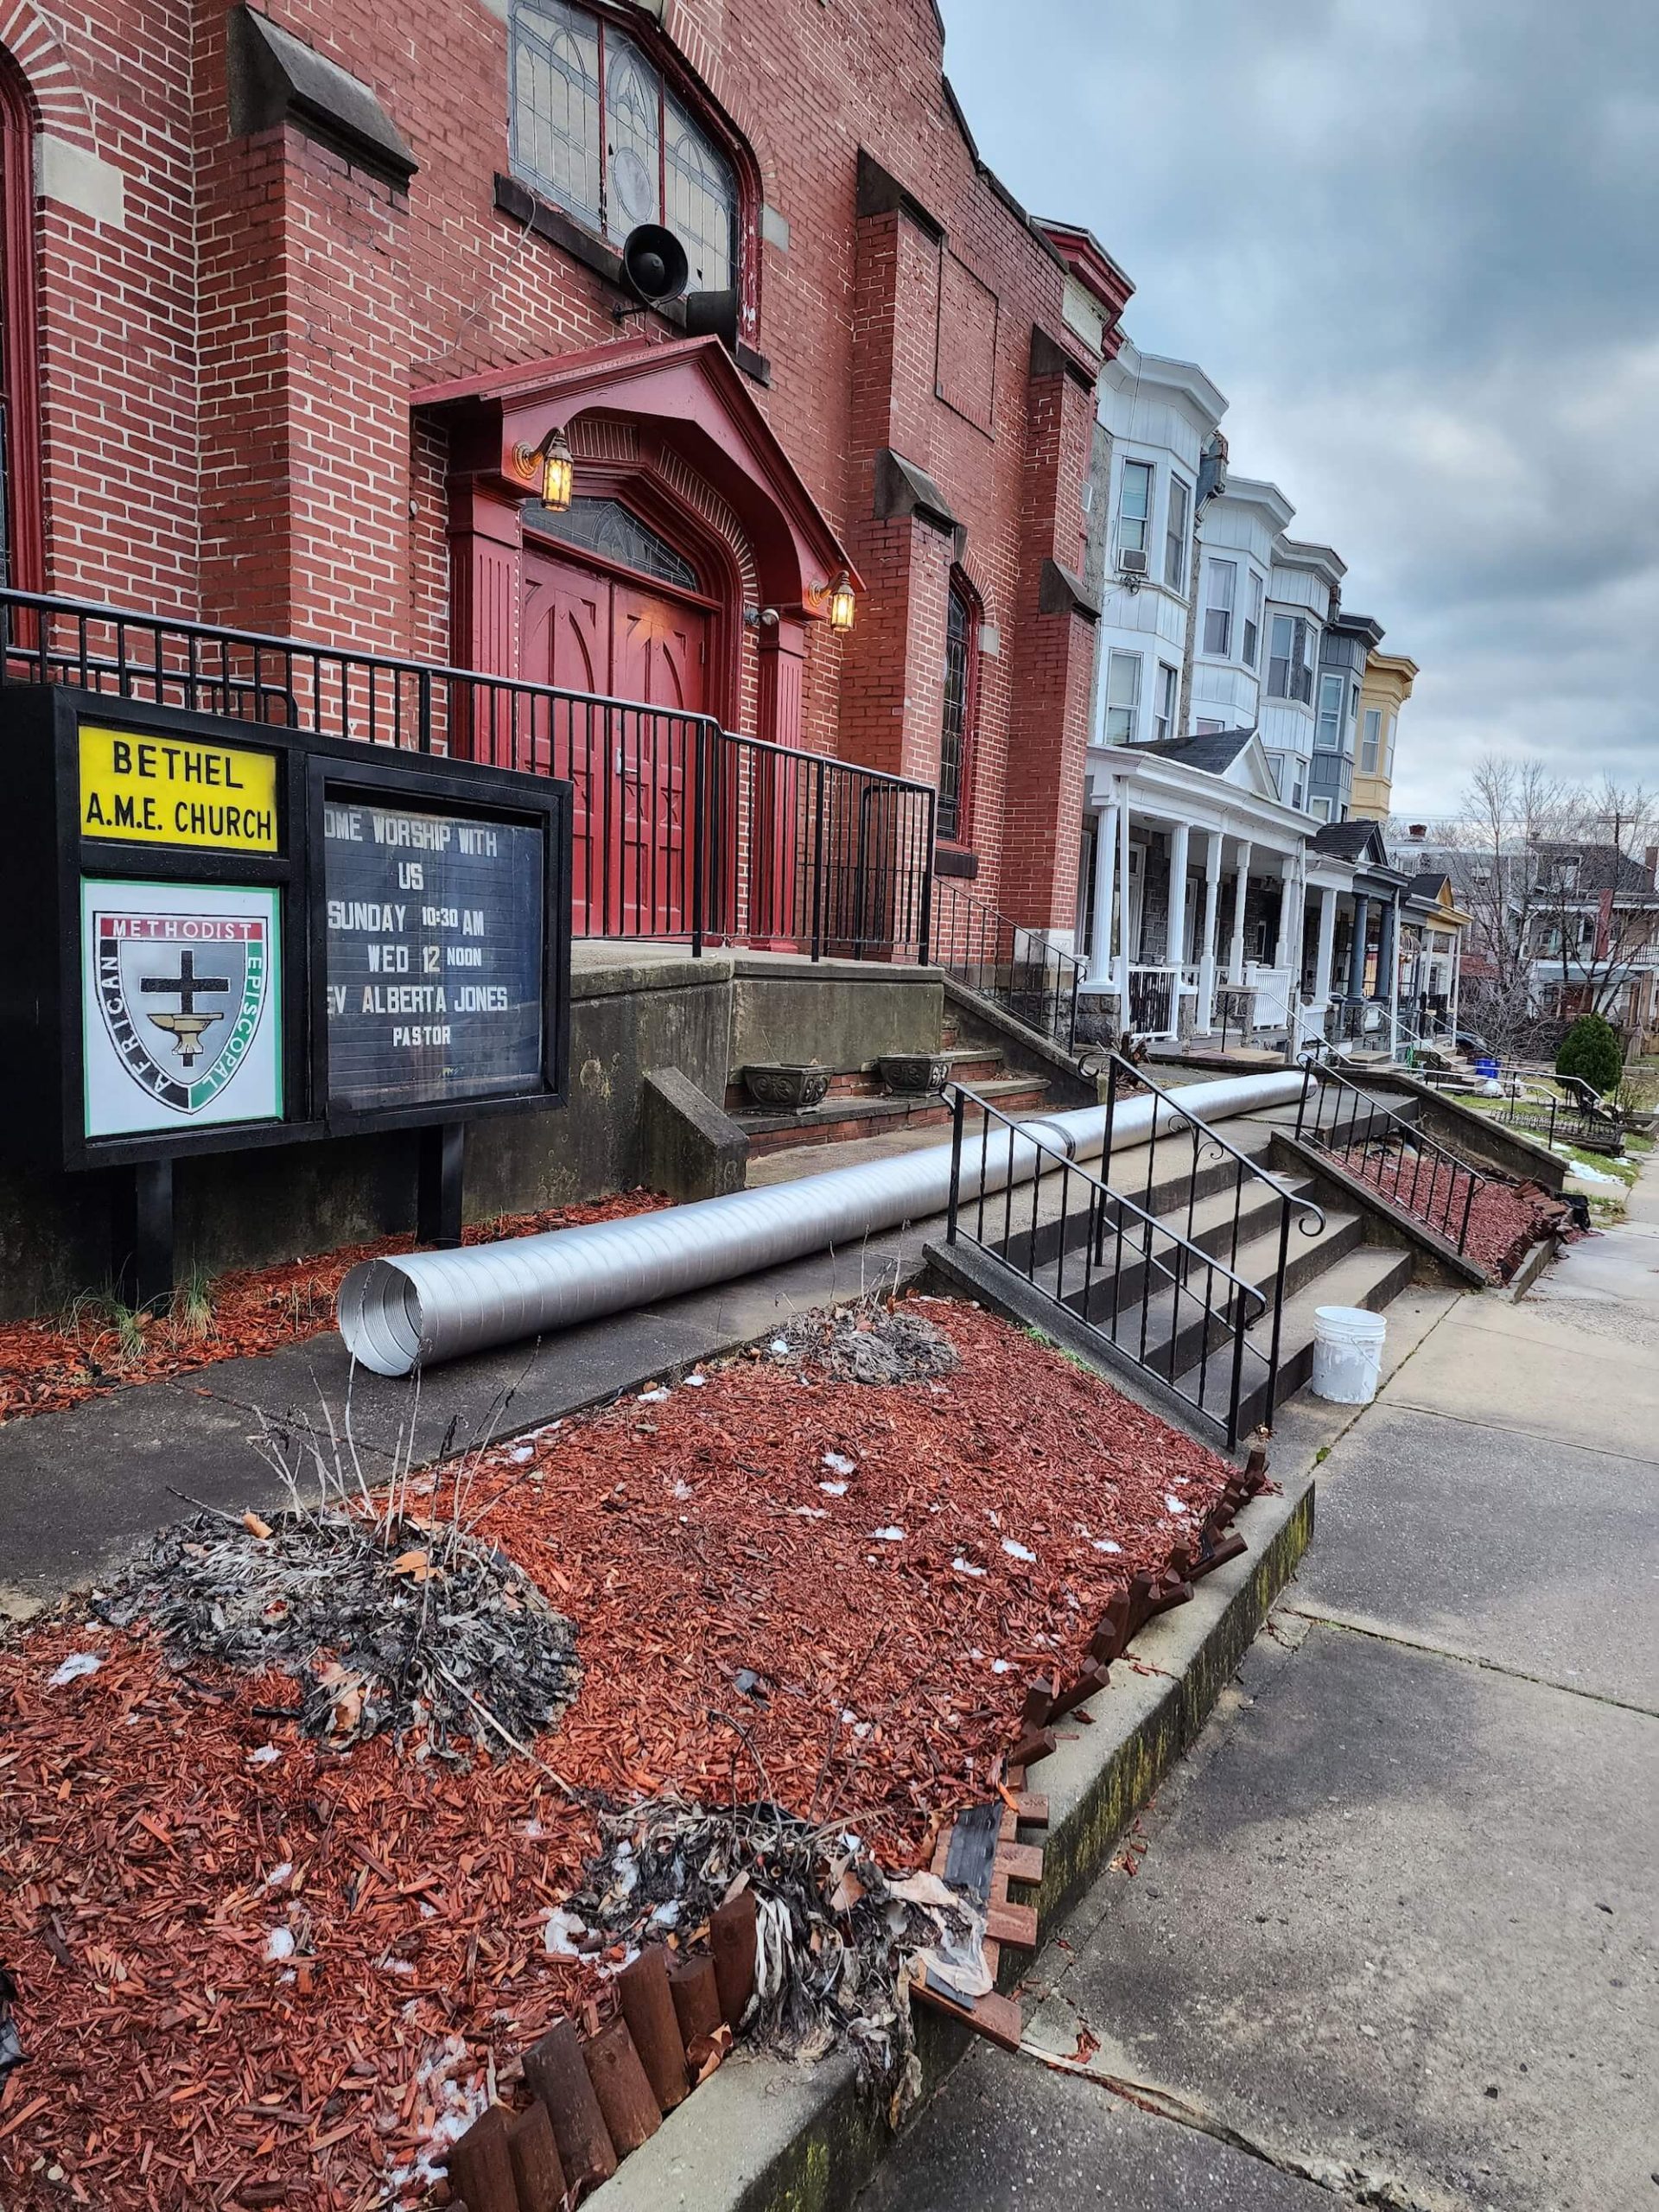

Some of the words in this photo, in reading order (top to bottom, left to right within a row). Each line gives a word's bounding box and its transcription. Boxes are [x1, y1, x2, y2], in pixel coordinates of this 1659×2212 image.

[112, 741, 244, 790] BETHEL
[86, 792, 163, 832] A.M.E.
[175, 801, 272, 840] CHURCH
[324, 809, 363, 842] OME
[372, 816, 451, 851] WORSHIP
[458, 827, 498, 857] WITH
[398, 862, 424, 890] US
[111, 917, 252, 940] METHODIST
[327, 900, 406, 932] SUNDAY
[422, 906, 459, 928] 10:30
[461, 910, 485, 936] AM
[367, 945, 409, 973] WED
[423, 946, 441, 973] 12
[447, 947, 482, 967] NOON
[327, 986, 346, 1014] EV
[362, 986, 447, 1014] ALBERTA
[454, 987, 508, 1012] JONES
[101, 956, 169, 1091] AFRICAN
[202, 956, 263, 1090] EPISCOPAL
[392, 1026, 451, 1046] PASTOR
